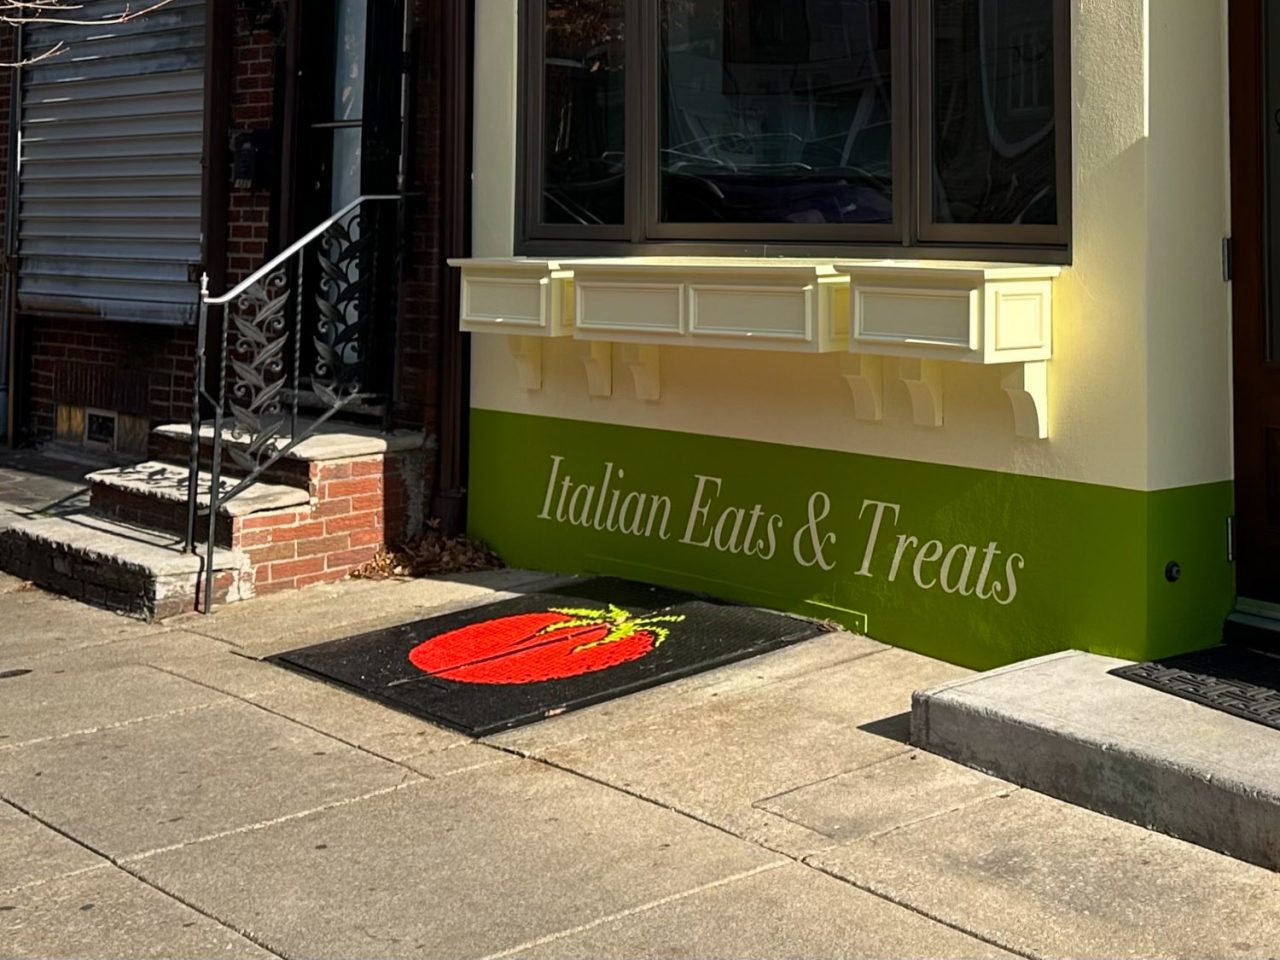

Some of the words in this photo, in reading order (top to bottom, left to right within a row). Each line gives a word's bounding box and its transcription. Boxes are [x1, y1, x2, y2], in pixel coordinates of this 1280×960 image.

[537, 455, 671, 540] Italian
[678, 474, 783, 561] Eats
[793, 491, 837, 571] &
[853, 499, 1025, 605] Treats
